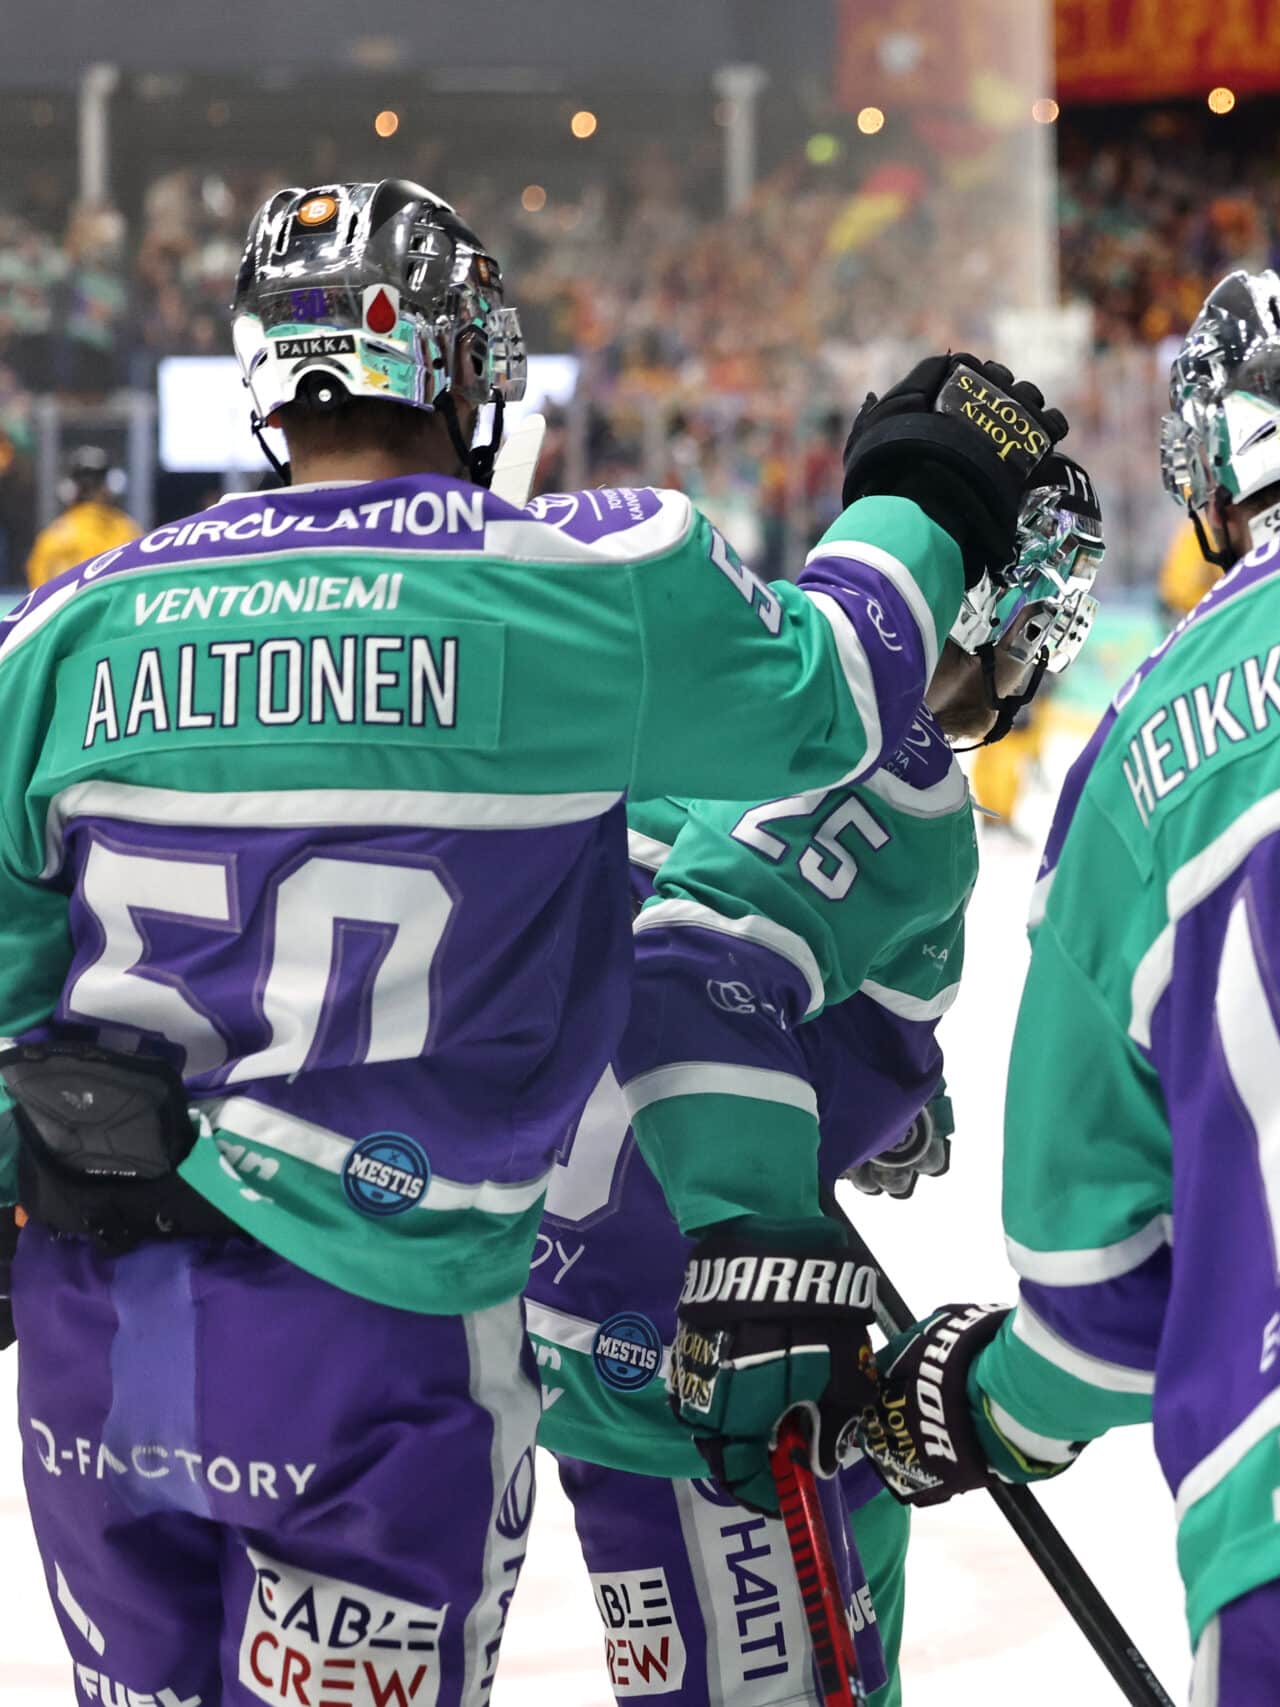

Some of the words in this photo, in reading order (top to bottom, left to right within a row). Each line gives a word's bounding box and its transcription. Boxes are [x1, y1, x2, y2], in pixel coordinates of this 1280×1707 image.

[279, 338, 351, 357] PAIKKA
[959, 399, 1022, 462] JOHN
[139, 490, 485, 553] CIRCULATION
[134, 573, 404, 627] VENTONIEMI
[82, 635, 459, 750] AALTONEN
[347, 1152, 425, 1200] MESTIS
[595, 1334, 659, 1371] MESTIS
[30, 1417, 317, 1500] Q-FACTORY
[256, 1567, 439, 1652] CABLE
[719, 1517, 790, 1682] HALTI
[249, 1630, 428, 1707] CREW
